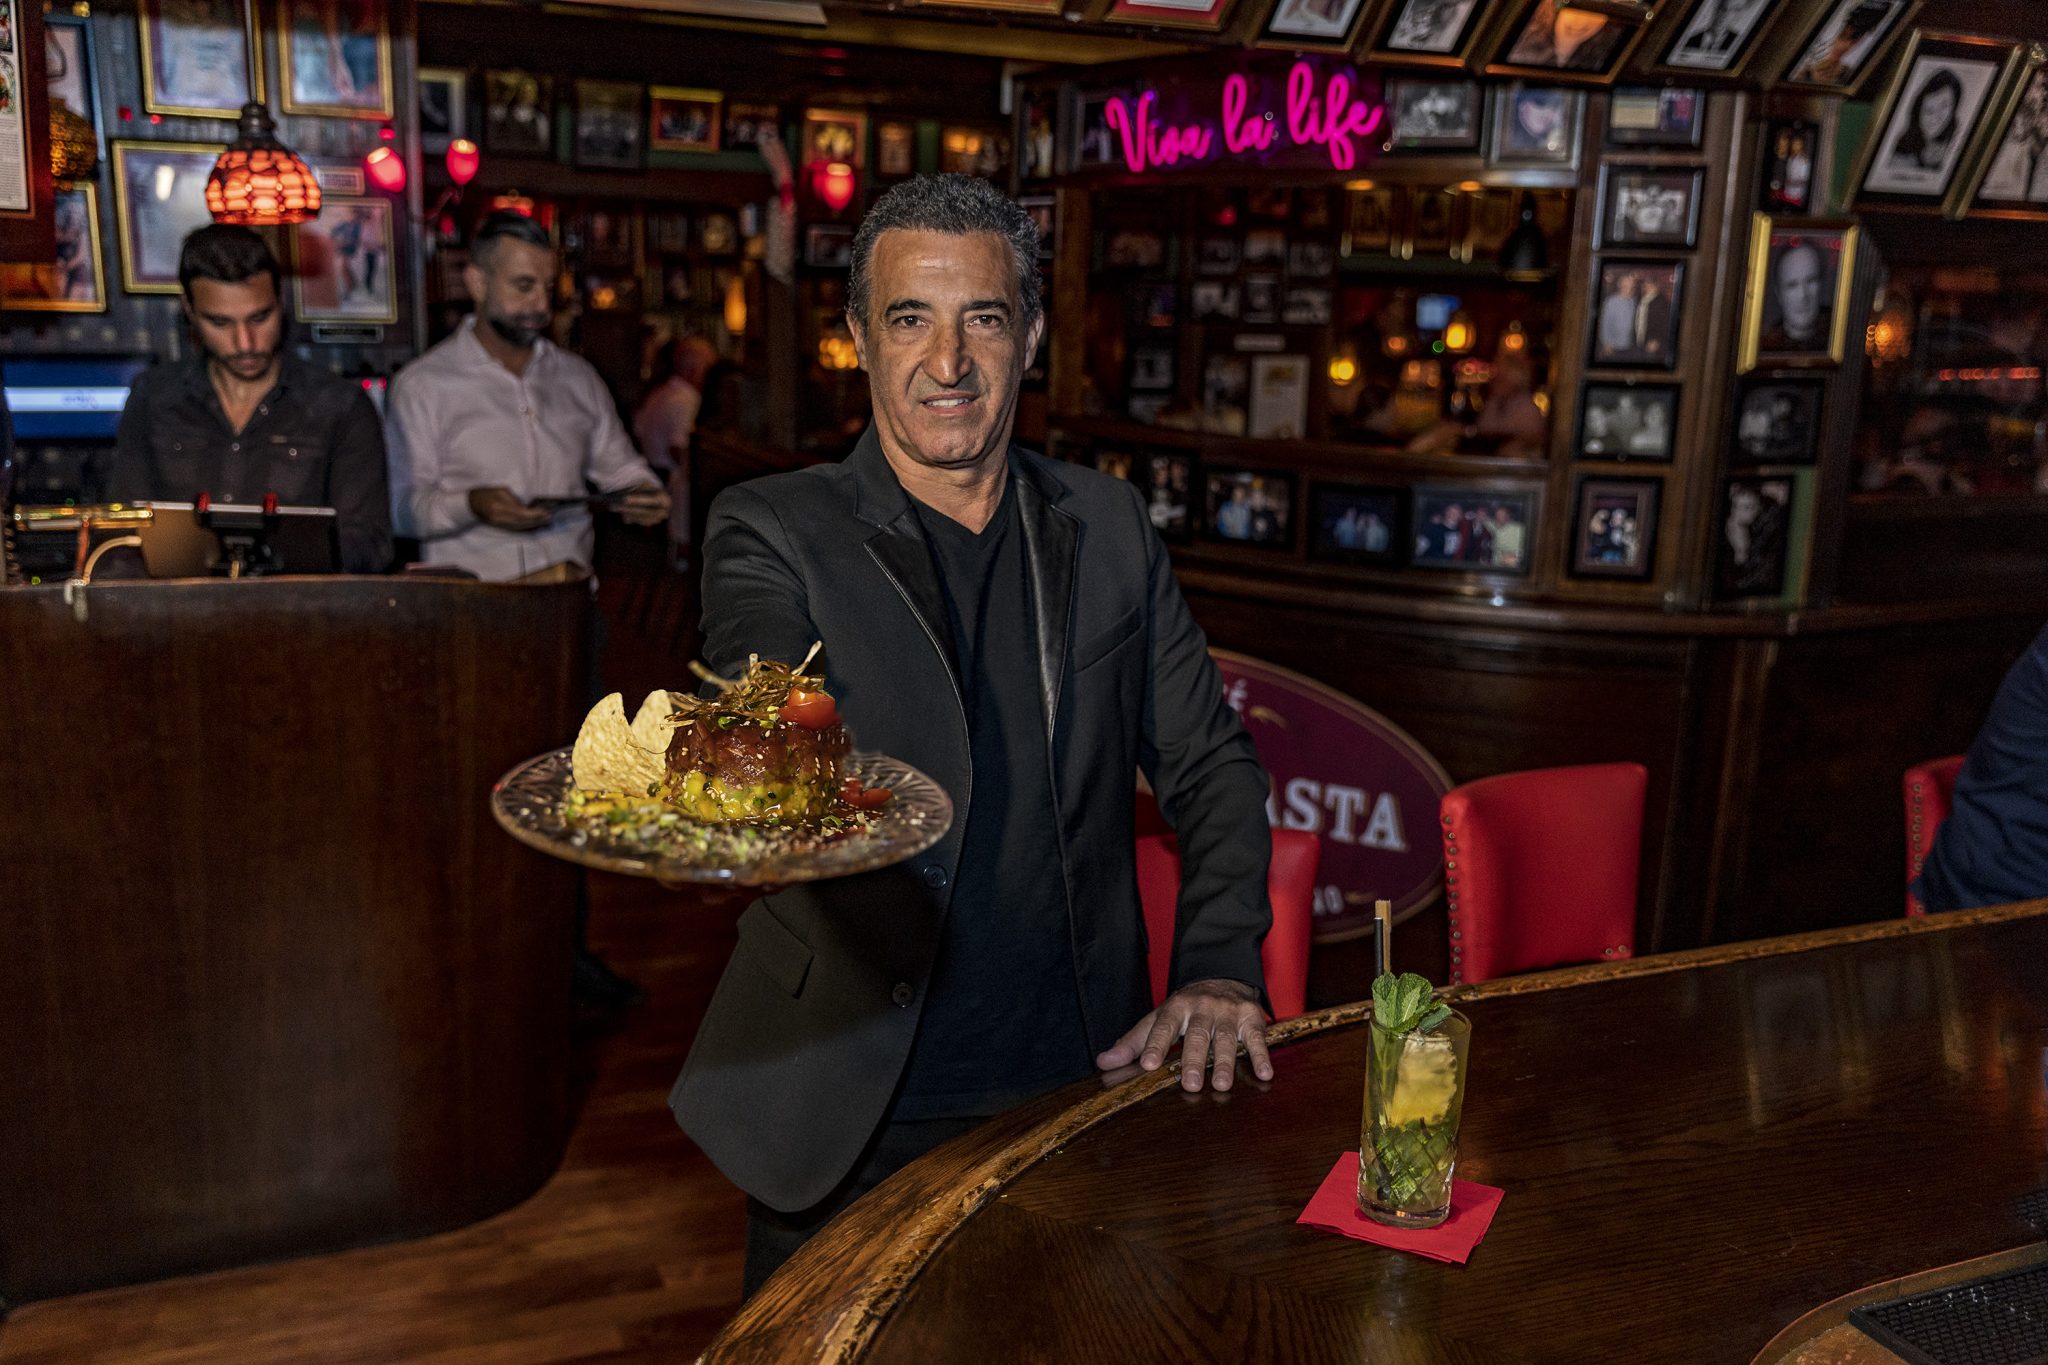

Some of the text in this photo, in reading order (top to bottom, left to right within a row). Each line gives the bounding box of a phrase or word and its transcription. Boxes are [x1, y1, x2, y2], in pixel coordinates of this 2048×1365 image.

[1105, 62, 1384, 172] Viva la life
